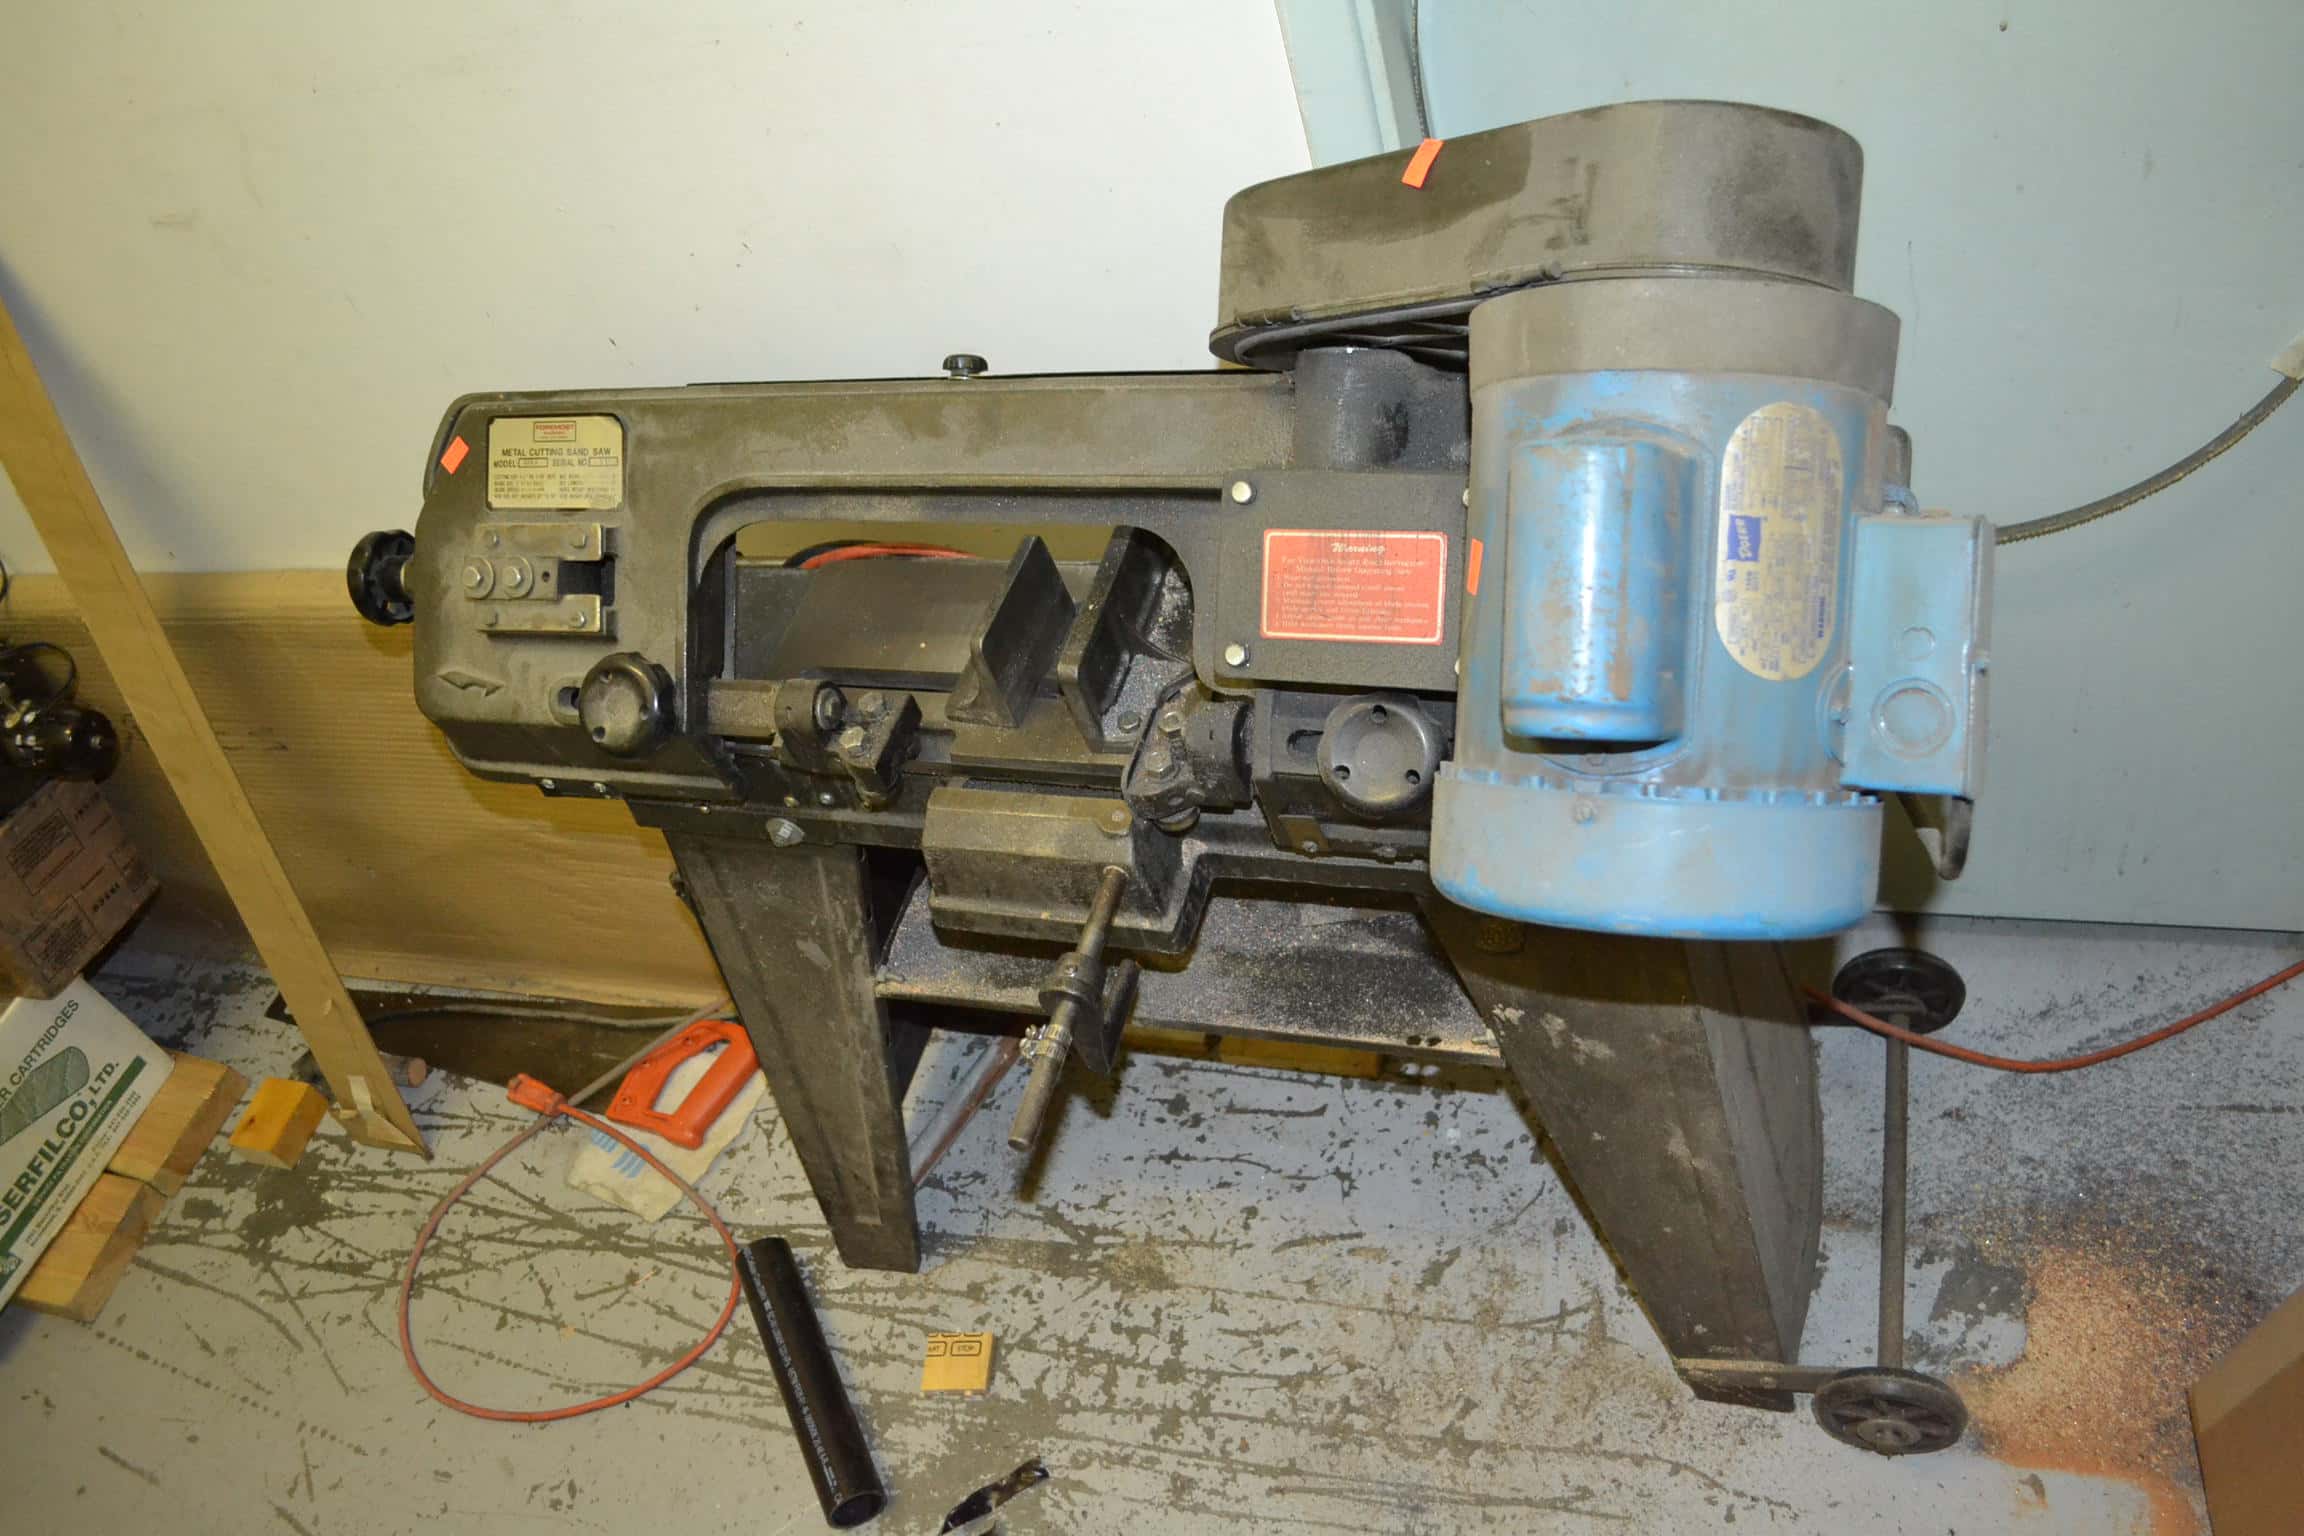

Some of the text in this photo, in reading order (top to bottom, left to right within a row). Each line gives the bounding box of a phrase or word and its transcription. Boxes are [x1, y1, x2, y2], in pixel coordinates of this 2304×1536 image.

[502, 448, 526, 457] METAL
[529, 448, 563, 457] CUTTING
[592, 447, 611, 456] SAW
[10, 999, 80, 1087] CARTRIDGES
[89, 1060, 120, 1096] LTD.
